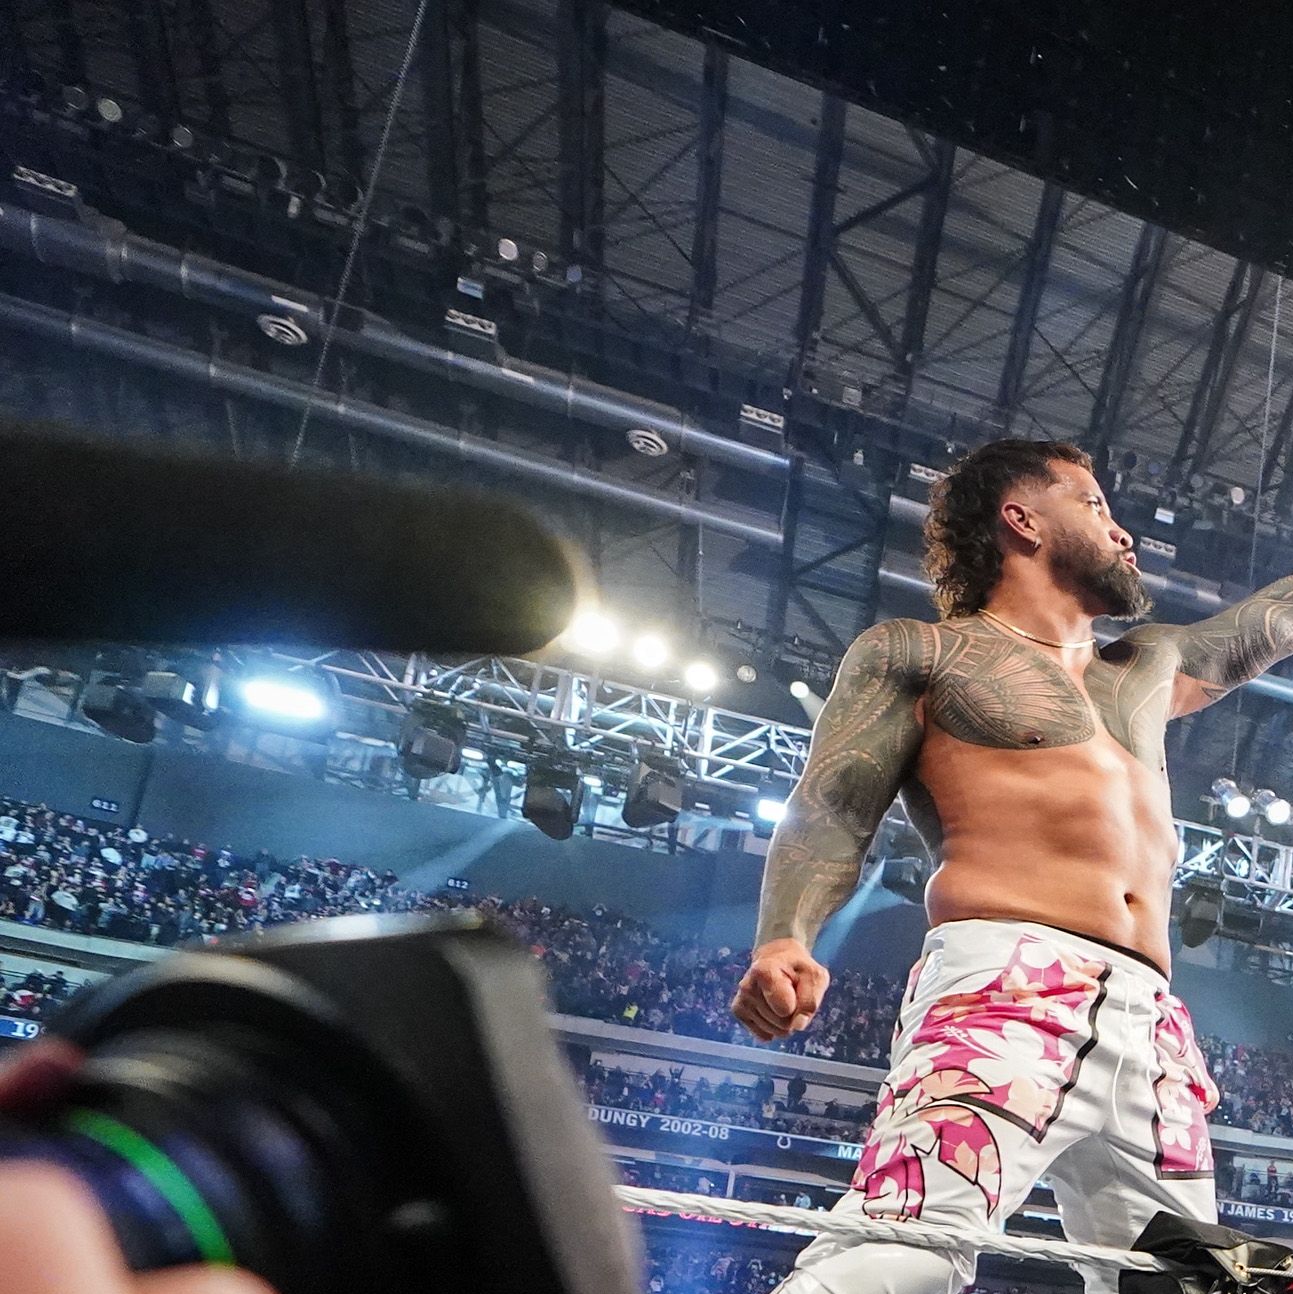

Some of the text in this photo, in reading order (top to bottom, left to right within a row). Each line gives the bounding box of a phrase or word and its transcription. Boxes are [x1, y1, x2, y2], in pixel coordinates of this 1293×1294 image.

[588, 1107, 729, 1140] DUNGY 2002-08
[1227, 1205, 1275, 1221] JAMES
